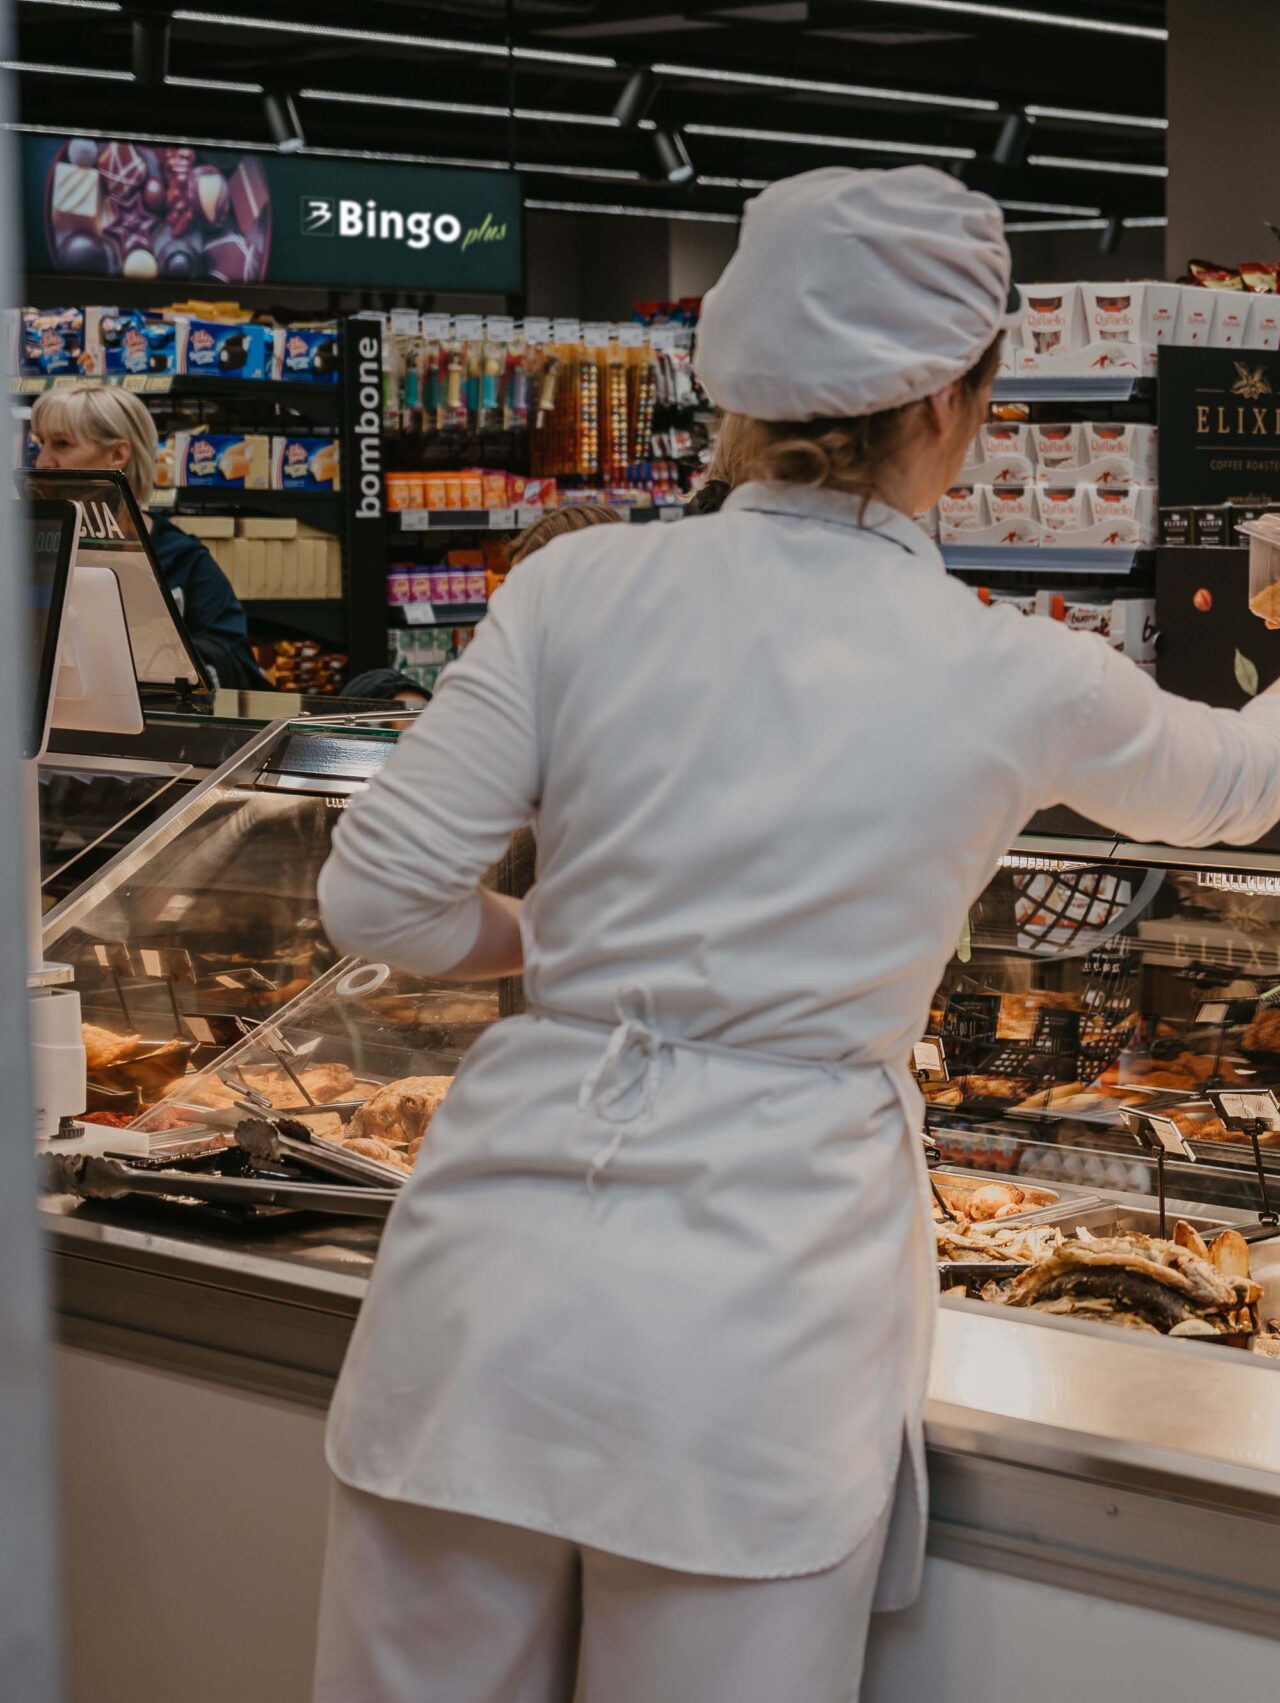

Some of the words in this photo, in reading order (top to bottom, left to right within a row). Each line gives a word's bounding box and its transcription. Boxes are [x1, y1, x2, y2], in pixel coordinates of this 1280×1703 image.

[339, 199, 461, 249] Bingo
[461, 213, 507, 253] plus
[1027, 313, 1066, 326] Raffaello
[1095, 313, 1134, 326] Raffaello
[355, 337, 381, 518] bombone
[1210, 459, 1243, 471] COFFEE
[1071, 612, 1099, 624] bueno
